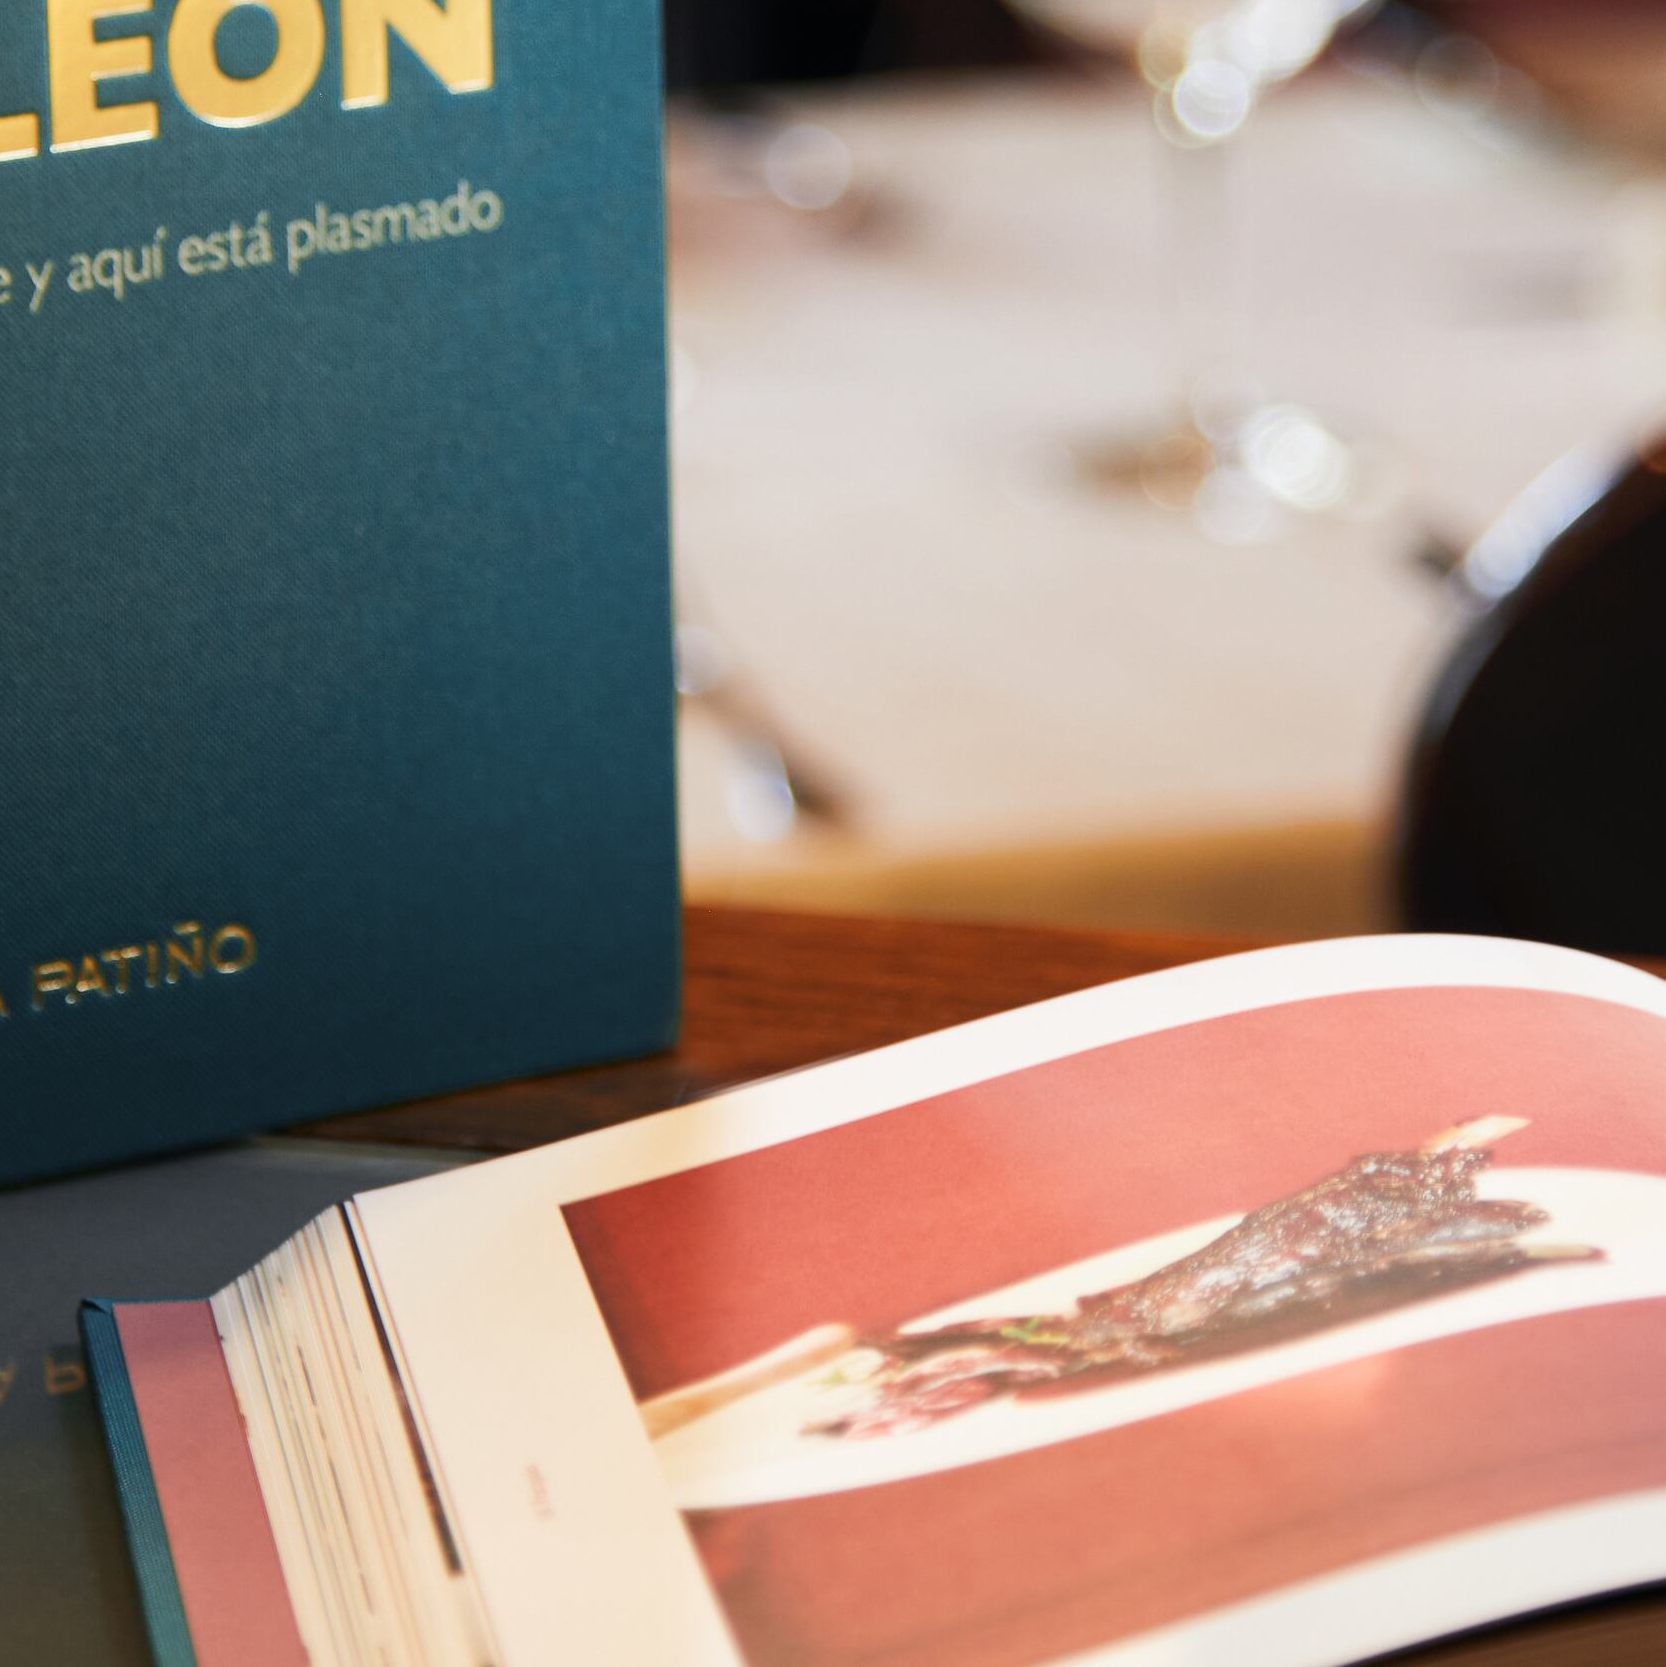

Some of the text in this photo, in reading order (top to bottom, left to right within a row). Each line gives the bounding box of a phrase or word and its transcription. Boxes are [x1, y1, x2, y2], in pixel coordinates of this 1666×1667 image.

[26, 256, 55, 314] y
[67, 227, 166, 301] aquí
[179, 212, 273, 276] está
[288, 180, 504, 273] plasmado
[32, 920, 257, 1012] PATIÑO
